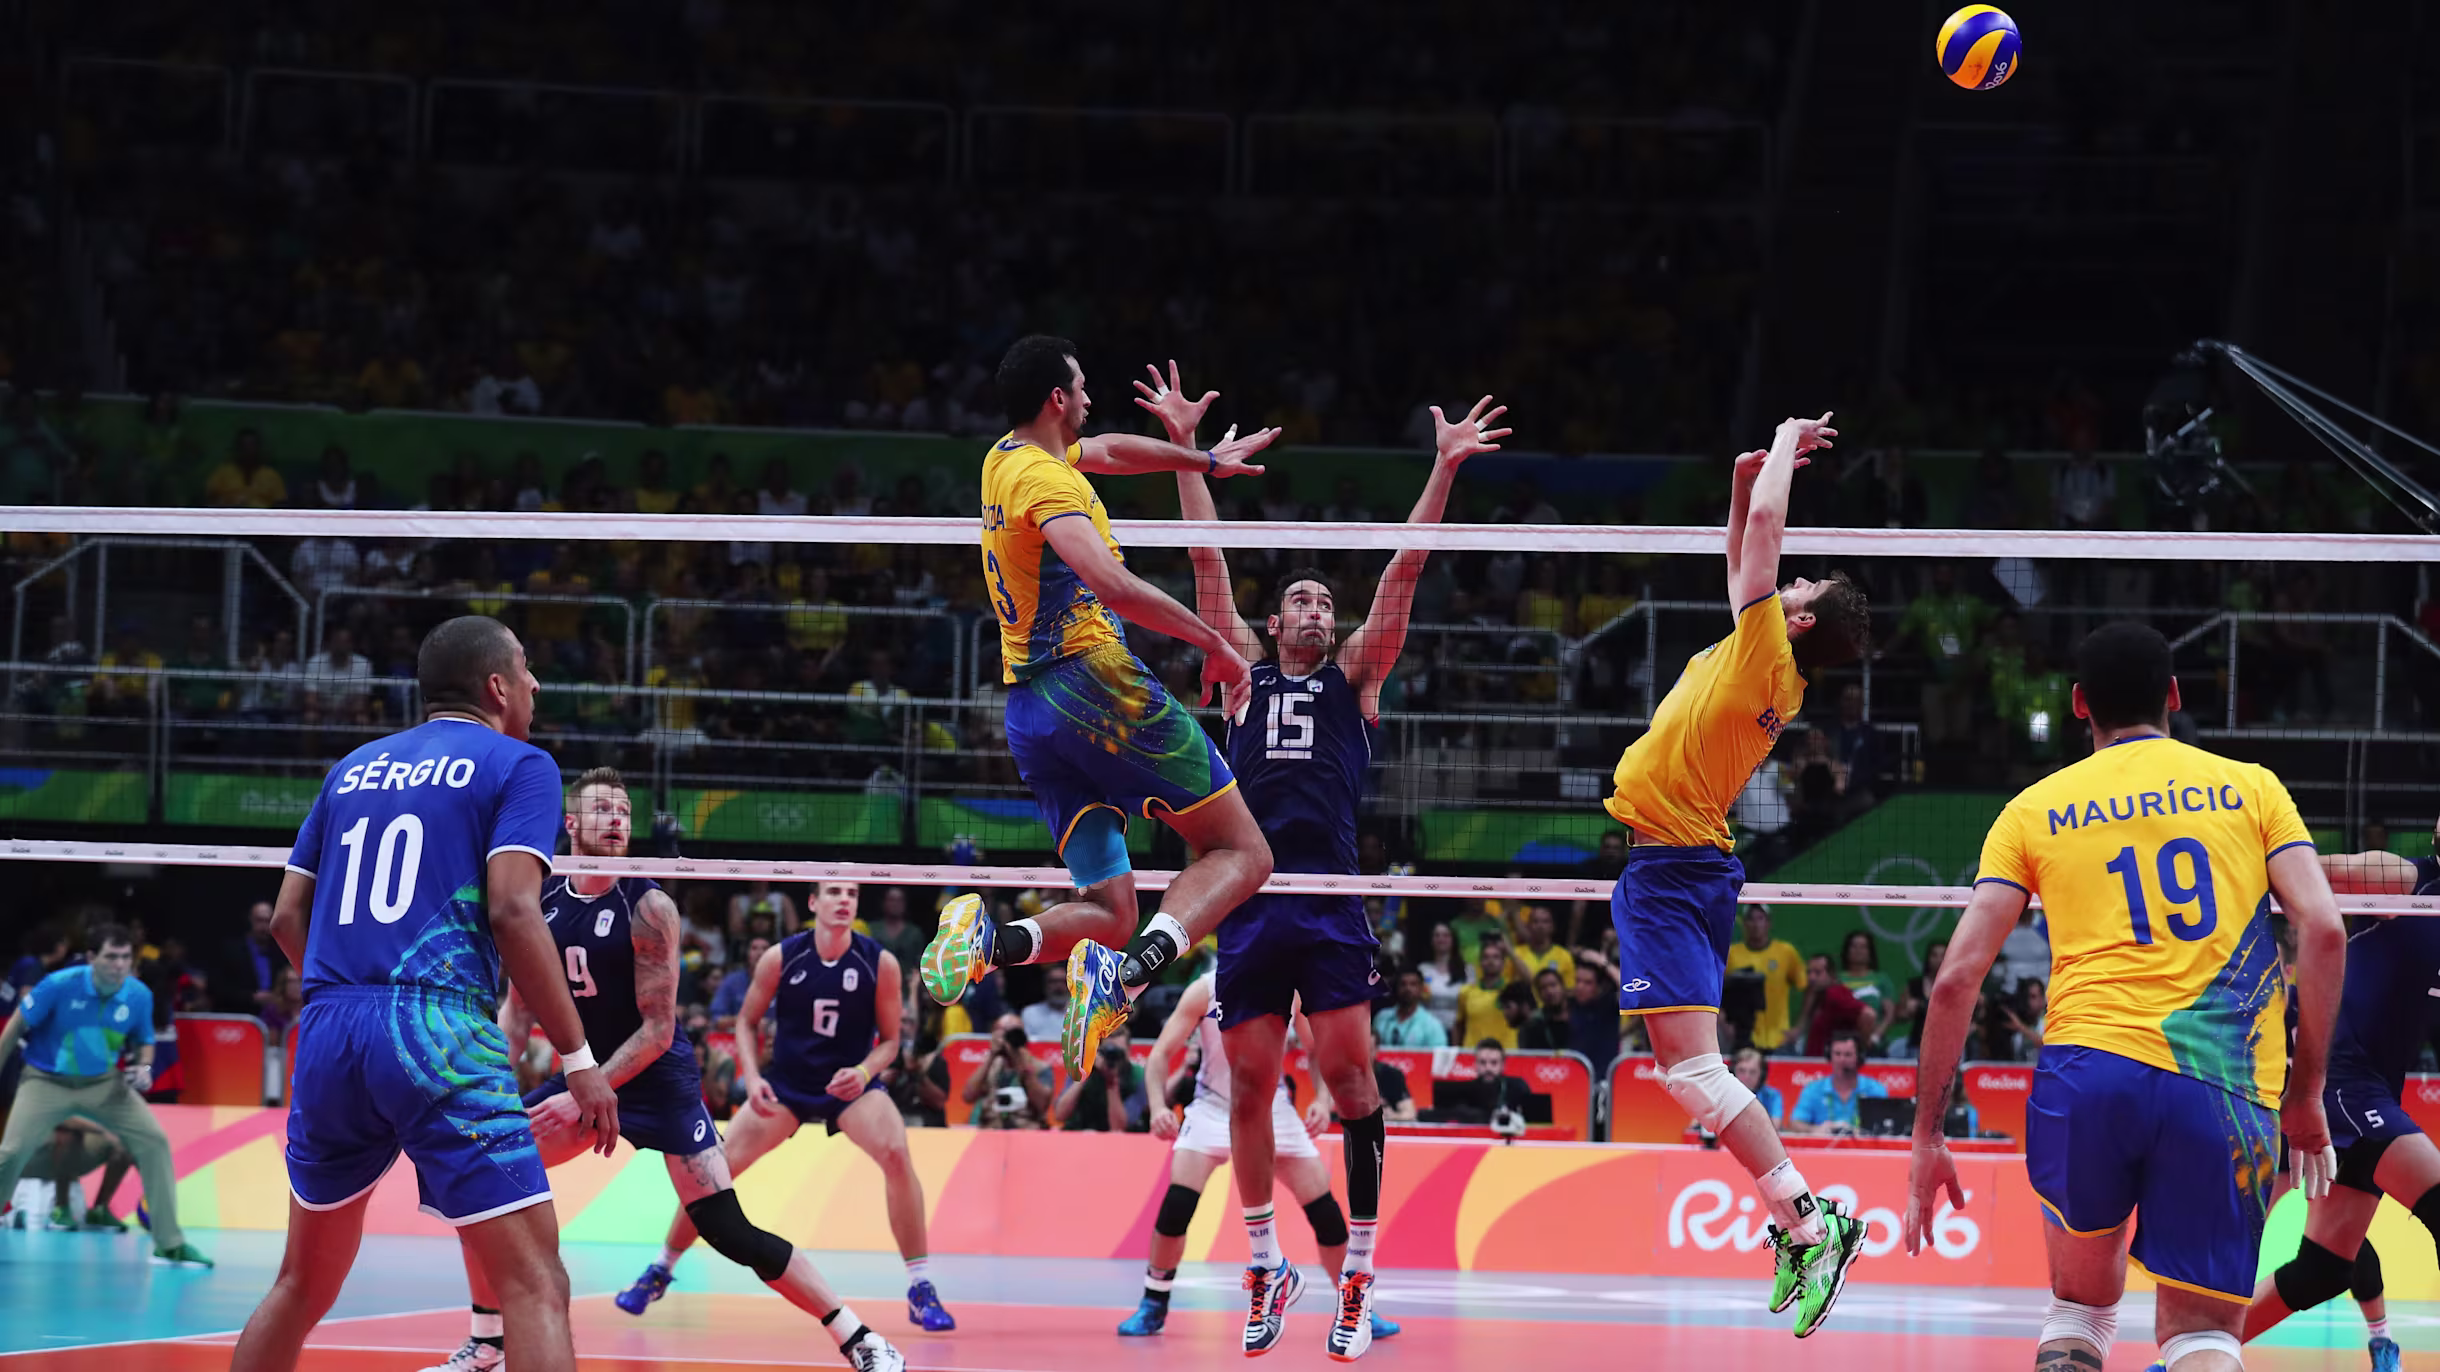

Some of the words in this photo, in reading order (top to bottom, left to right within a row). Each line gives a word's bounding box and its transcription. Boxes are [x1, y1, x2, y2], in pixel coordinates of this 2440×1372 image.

[987, 550, 1018, 625] 3
[1266, 692, 1315, 749] 15
[337, 752, 476, 795] SÉRGIO
[2048, 779, 2243, 836] MAURÍCIO
[338, 813, 424, 926] 10
[1472, 884, 1494, 892] Rio2016
[1575, 886, 1596, 894] Rio2016
[2105, 837, 2218, 945] 19
[1781, 890, 1803, 898] Rio2016
[1885, 892, 1907, 900] Rio2016
[2411, 902, 2433, 910] Rio2016
[565, 945, 598, 998] 9
[813, 998, 840, 1038] 6
[2364, 1109, 2385, 1128] 5
[1668, 1179, 1980, 1260] Ri06
